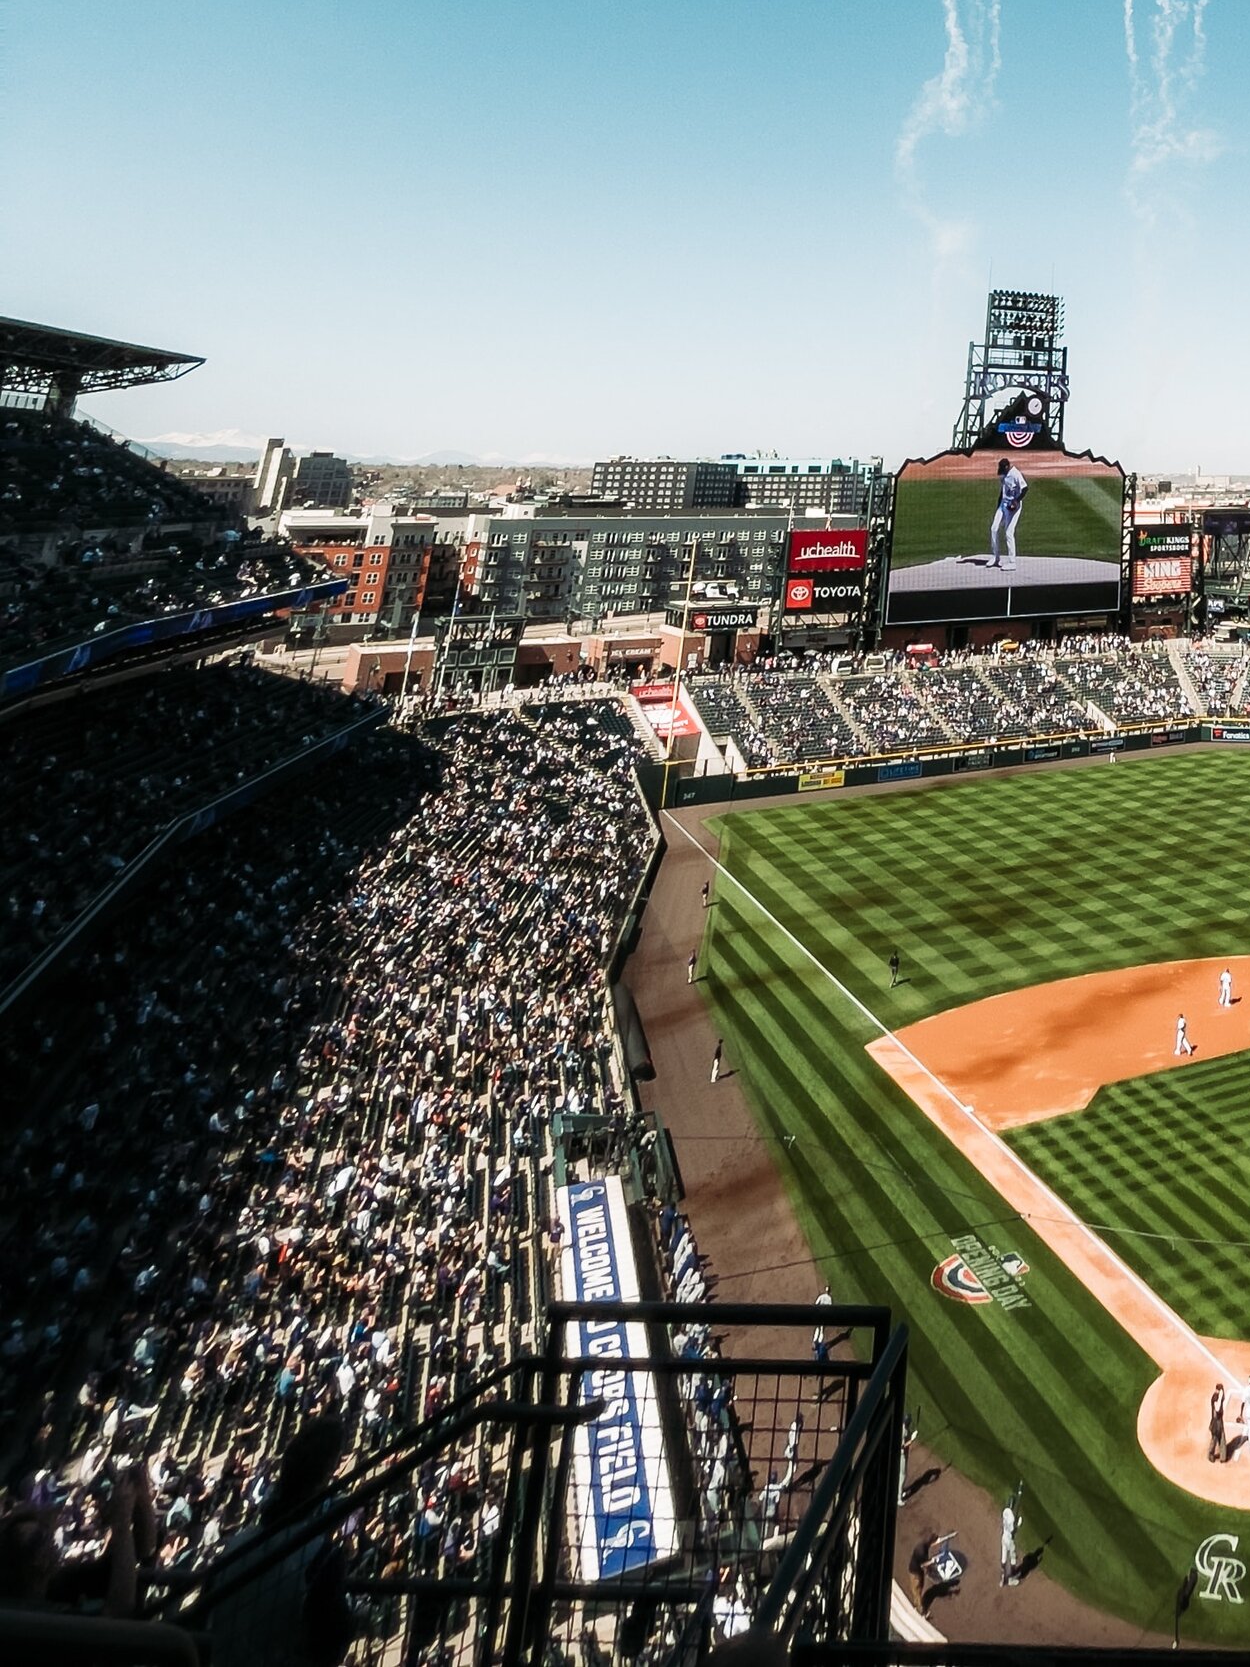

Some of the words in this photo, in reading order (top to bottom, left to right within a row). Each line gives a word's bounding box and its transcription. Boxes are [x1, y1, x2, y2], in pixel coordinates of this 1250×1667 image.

[801, 541, 856, 558] uchealth
[813, 585, 861, 598] TOYOTA
[706, 613, 753, 626] TUNDRA
[1222, 731, 1249, 740] Fanatics
[951, 1234, 1010, 1287] OPENING
[991, 1284, 1032, 1311] DAY
[576, 1204, 615, 1302] WELCOME
[597, 1420, 641, 1513] FIELD
